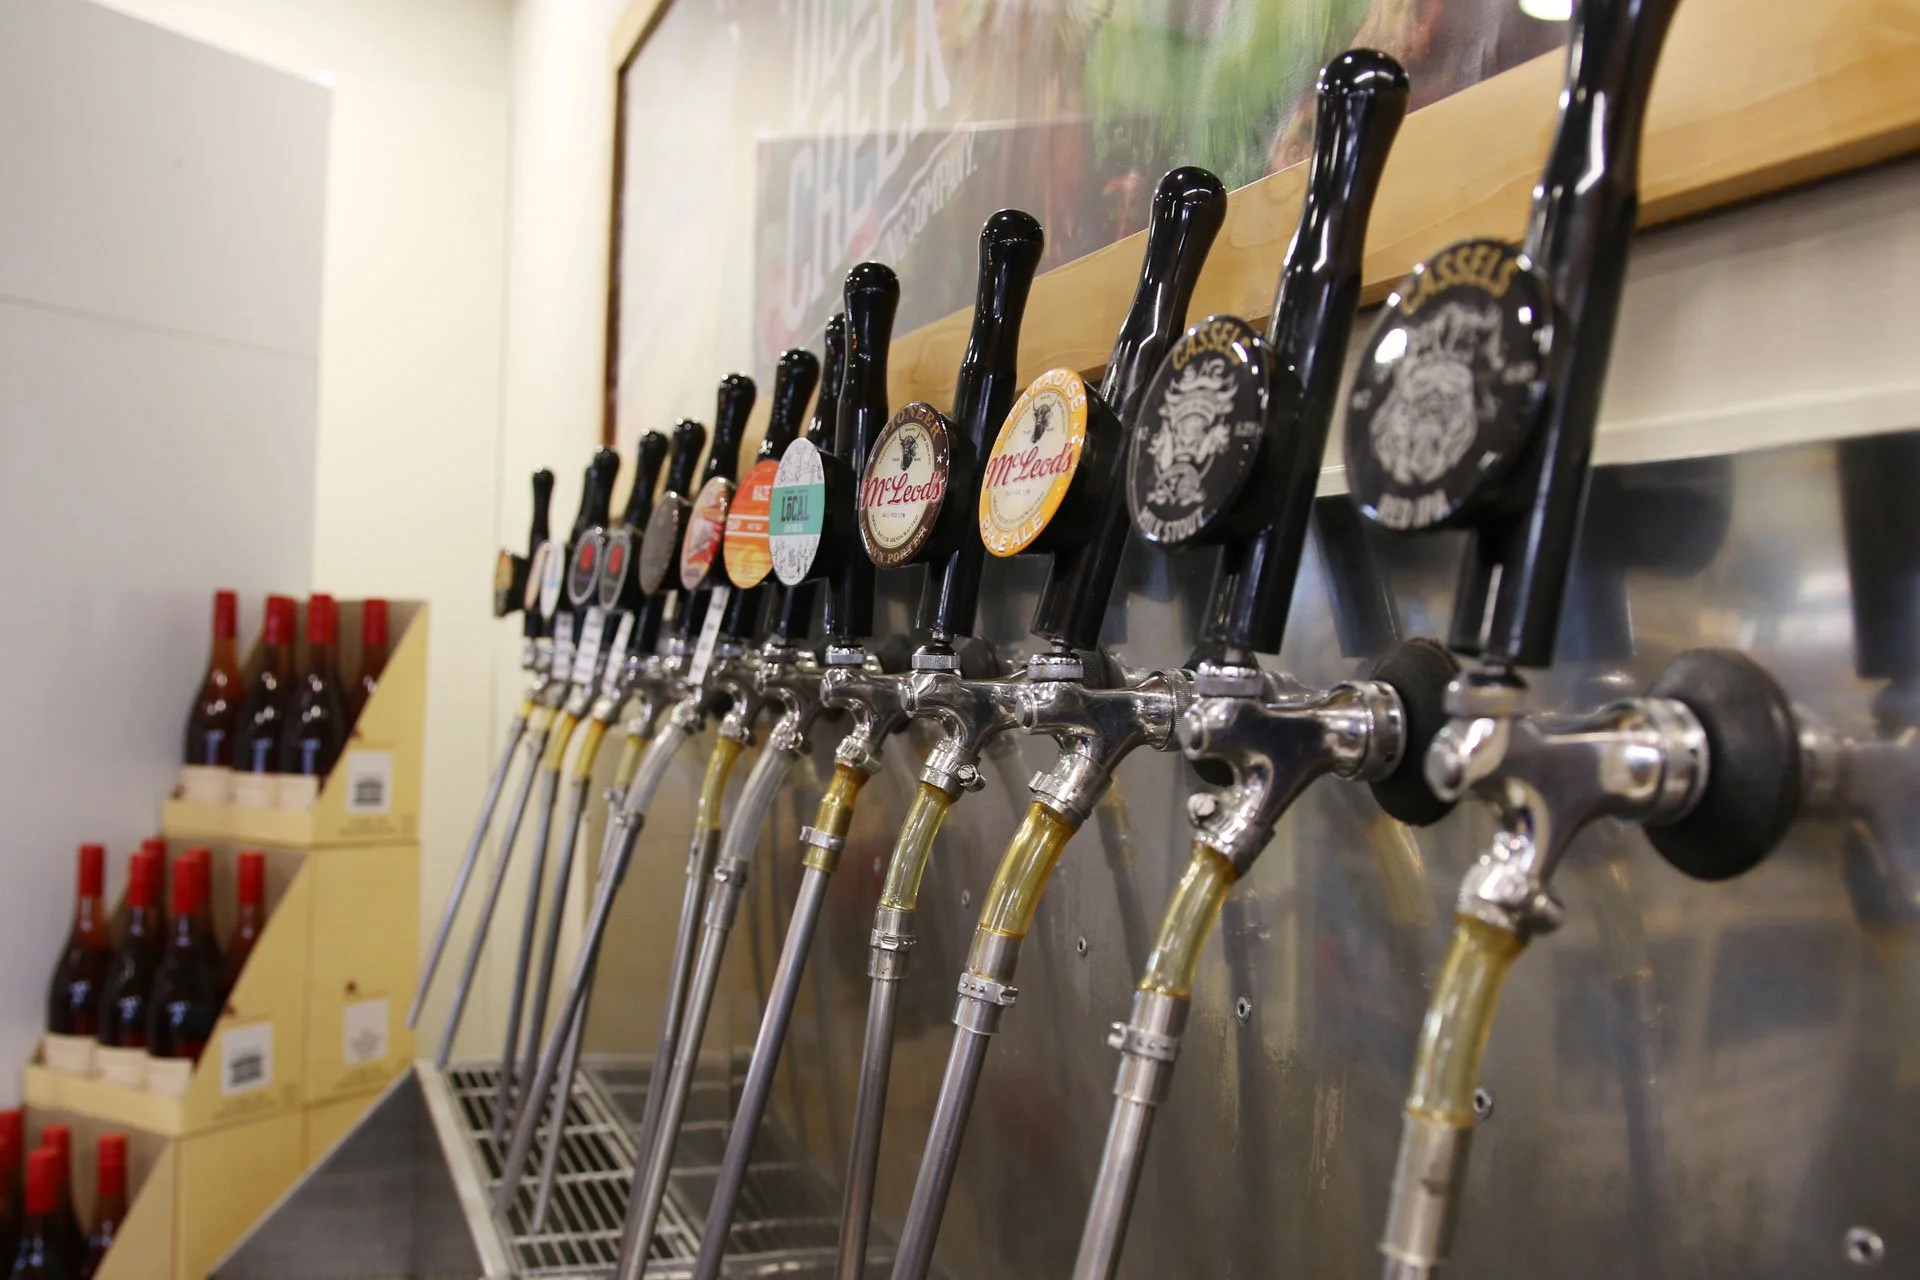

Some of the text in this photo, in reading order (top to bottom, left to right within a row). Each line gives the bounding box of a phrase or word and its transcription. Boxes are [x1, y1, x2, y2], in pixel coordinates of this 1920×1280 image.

[1400, 244, 1519, 317] CASSELS
[986, 442, 1073, 489] McLeod's
[861, 472, 942, 508] McLeod's
[980, 511, 1044, 552] PALE ALE
[1163, 506, 1204, 543] STOUT
